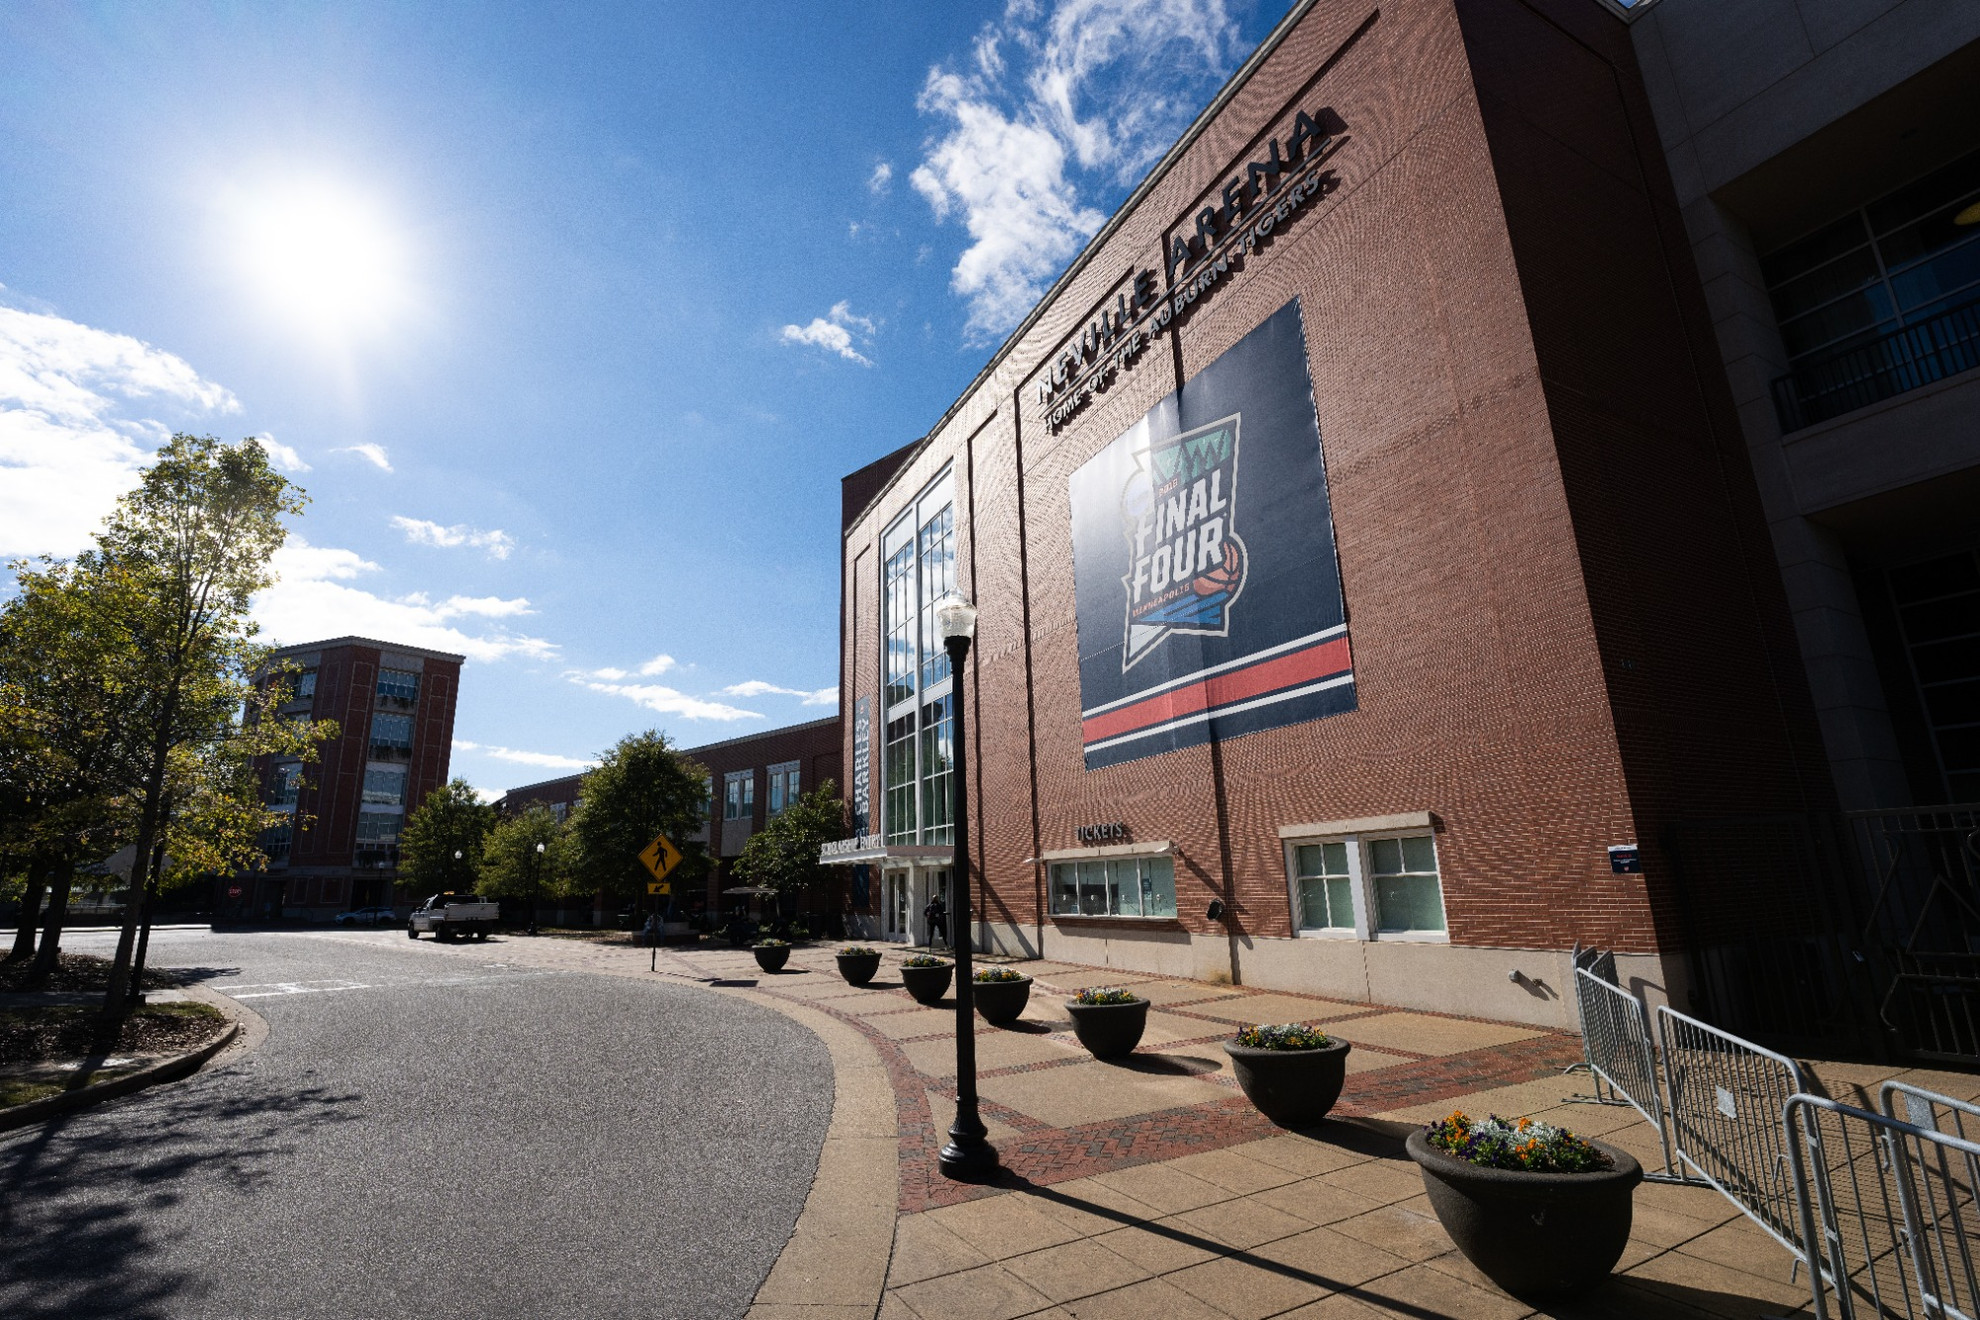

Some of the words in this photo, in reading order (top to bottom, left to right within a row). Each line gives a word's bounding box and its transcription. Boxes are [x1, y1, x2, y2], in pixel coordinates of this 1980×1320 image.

[1035, 268, 1150, 405] NEVILLE
[1167, 109, 1322, 278] ARENA
[1045, 388, 1082, 434] HOME
[1088, 364, 1108, 392] OF
[1113, 330, 1141, 370] THE
[1147, 252, 1228, 339] AUBURN
[1237, 169, 1319, 255] TIGERS
[1134, 468, 1227, 559] FINAL
[1132, 516, 1224, 604] FOUR
[860, 833, 881, 849] ENTRY
[1076, 820, 1123, 841] TICKETS
